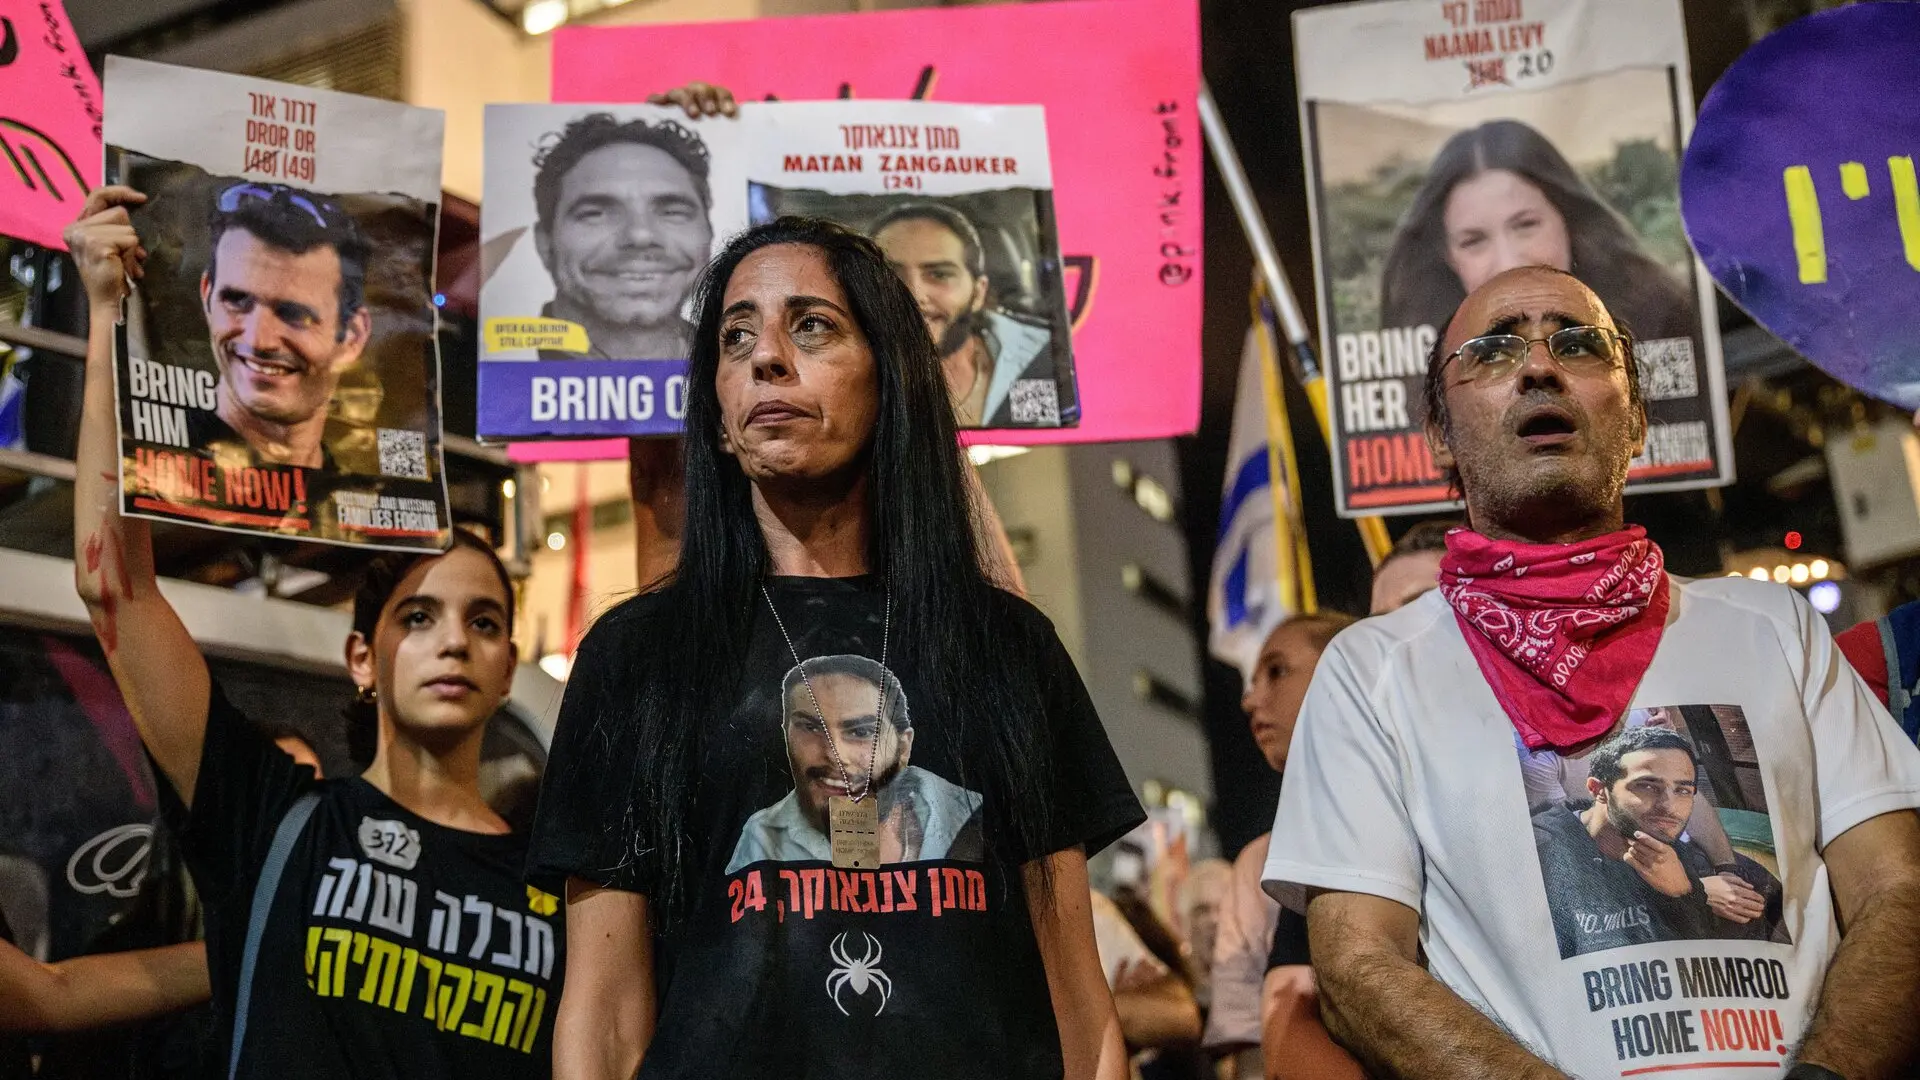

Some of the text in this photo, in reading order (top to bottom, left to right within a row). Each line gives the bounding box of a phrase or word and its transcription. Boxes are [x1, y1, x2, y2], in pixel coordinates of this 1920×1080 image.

[1425, 22, 1545, 60] NAAMA LEVY
[1518, 48, 1553, 79] 20
[248, 92, 317, 126] דרור אור
[246, 120, 315, 152] DROR OR
[925, 126, 960, 150] מתן
[282, 152, 316, 184] (49)
[783, 155, 1018, 175] MATAN ZANGAUKER
[882, 174, 923, 190] (24)
[1337, 323, 1437, 381] BRING
[130, 357, 217, 412] BRING
[531, 375, 654, 422] BRING
[1341, 379, 1410, 433] HER
[131, 399, 190, 448] HIM
[135, 447, 307, 514] HOME NOW!
[368, 829, 411, 858] 372
[312, 856, 555, 980] תכלה שנה
[728, 867, 987, 924] מתן צנגאוקר, 24
[1583, 957, 1790, 1012] BRING MIMROD
[1611, 1008, 1787, 1060] HOME NOW!
